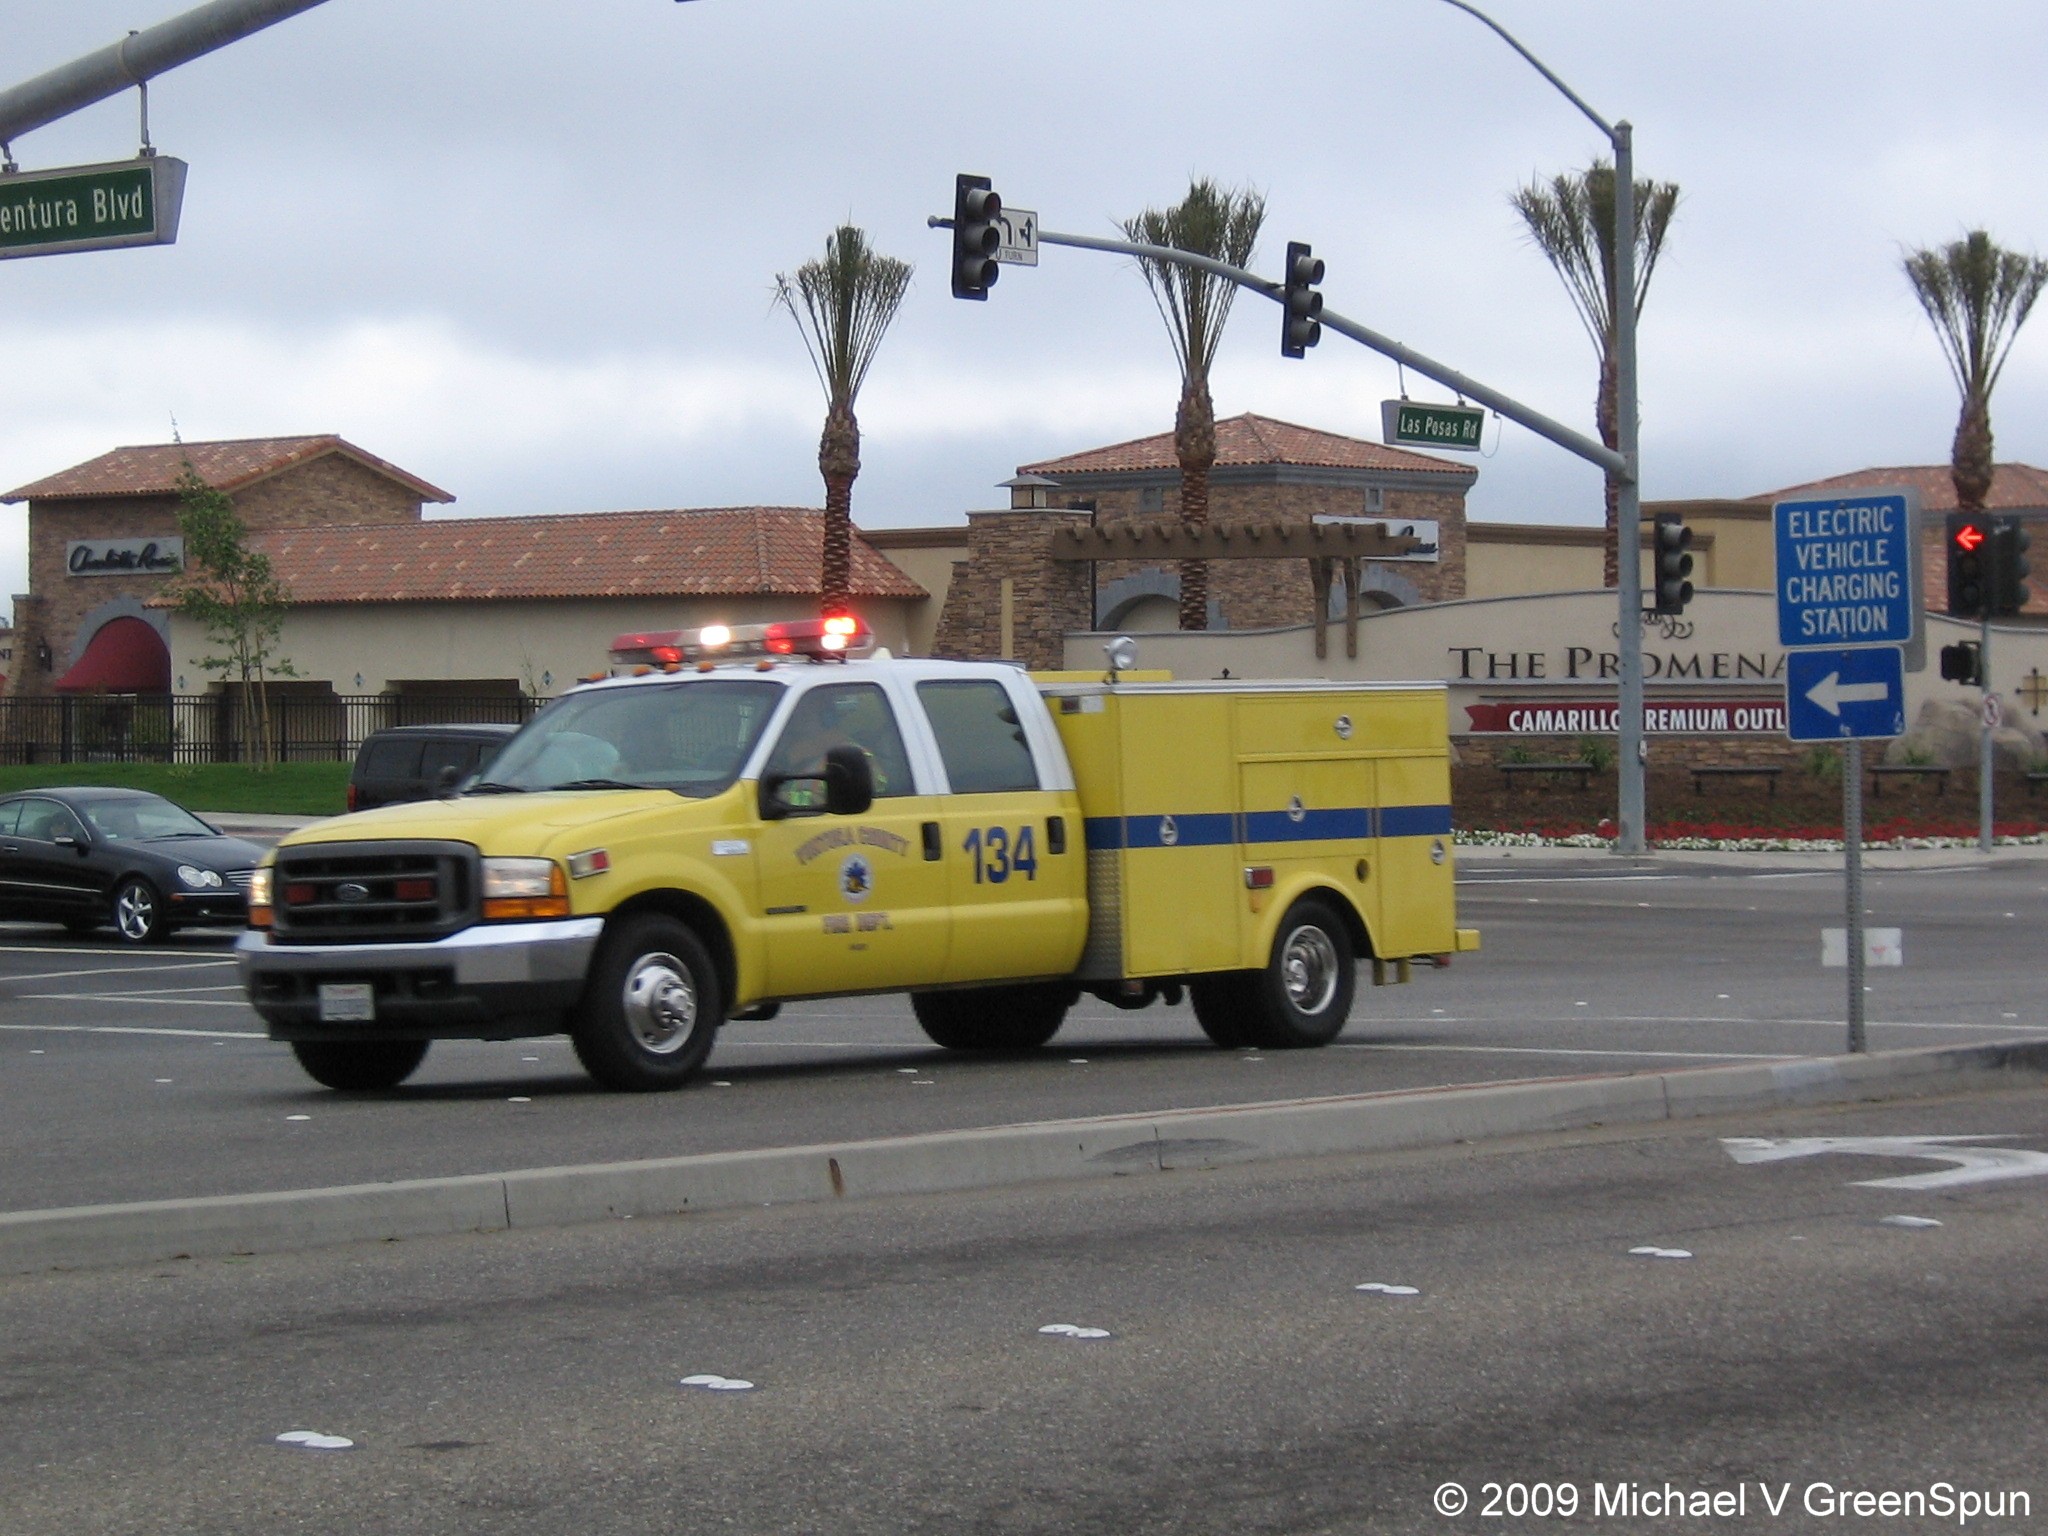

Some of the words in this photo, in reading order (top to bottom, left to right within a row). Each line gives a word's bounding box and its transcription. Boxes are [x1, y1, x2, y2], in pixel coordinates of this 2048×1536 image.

[0, 197, 78, 233] entura
[92, 185, 143, 224] Blvd
[1400, 414, 1420, 433] Las
[1425, 416, 1458, 437] Posas
[1462, 420, 1478, 439] Rd
[1788, 506, 1894, 538] ELECTRIC
[1796, 539, 1889, 570] VEHICLE
[1786, 571, 1900, 603] CHARGING
[1801, 605, 1888, 636] STATION
[1566, 647, 1786, 679] PROMENA
[1644, 708, 1728, 731] REMIUM
[1734, 708, 1787, 730] OUTL
[963, 825, 1037, 884] 134
